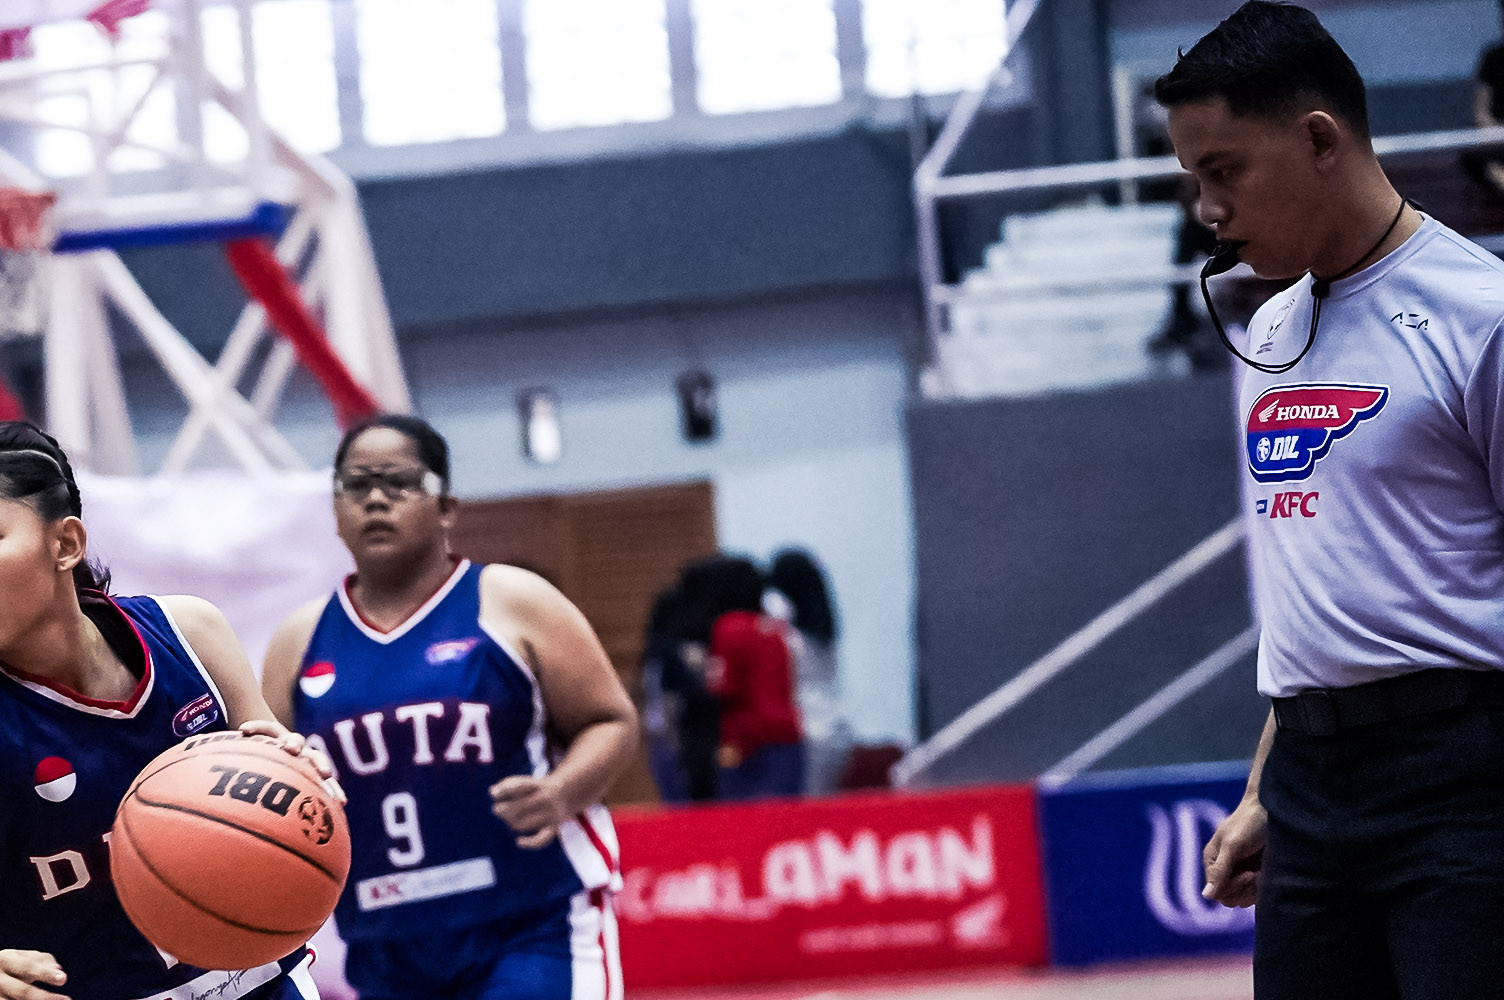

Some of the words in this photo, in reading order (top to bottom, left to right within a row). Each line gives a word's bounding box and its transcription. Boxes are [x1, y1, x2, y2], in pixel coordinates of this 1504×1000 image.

[1276, 405, 1340, 421] HONDA
[1269, 491, 1319, 519] KFC
[207, 765, 300, 817] DBL
[382, 791, 425, 867] 9
